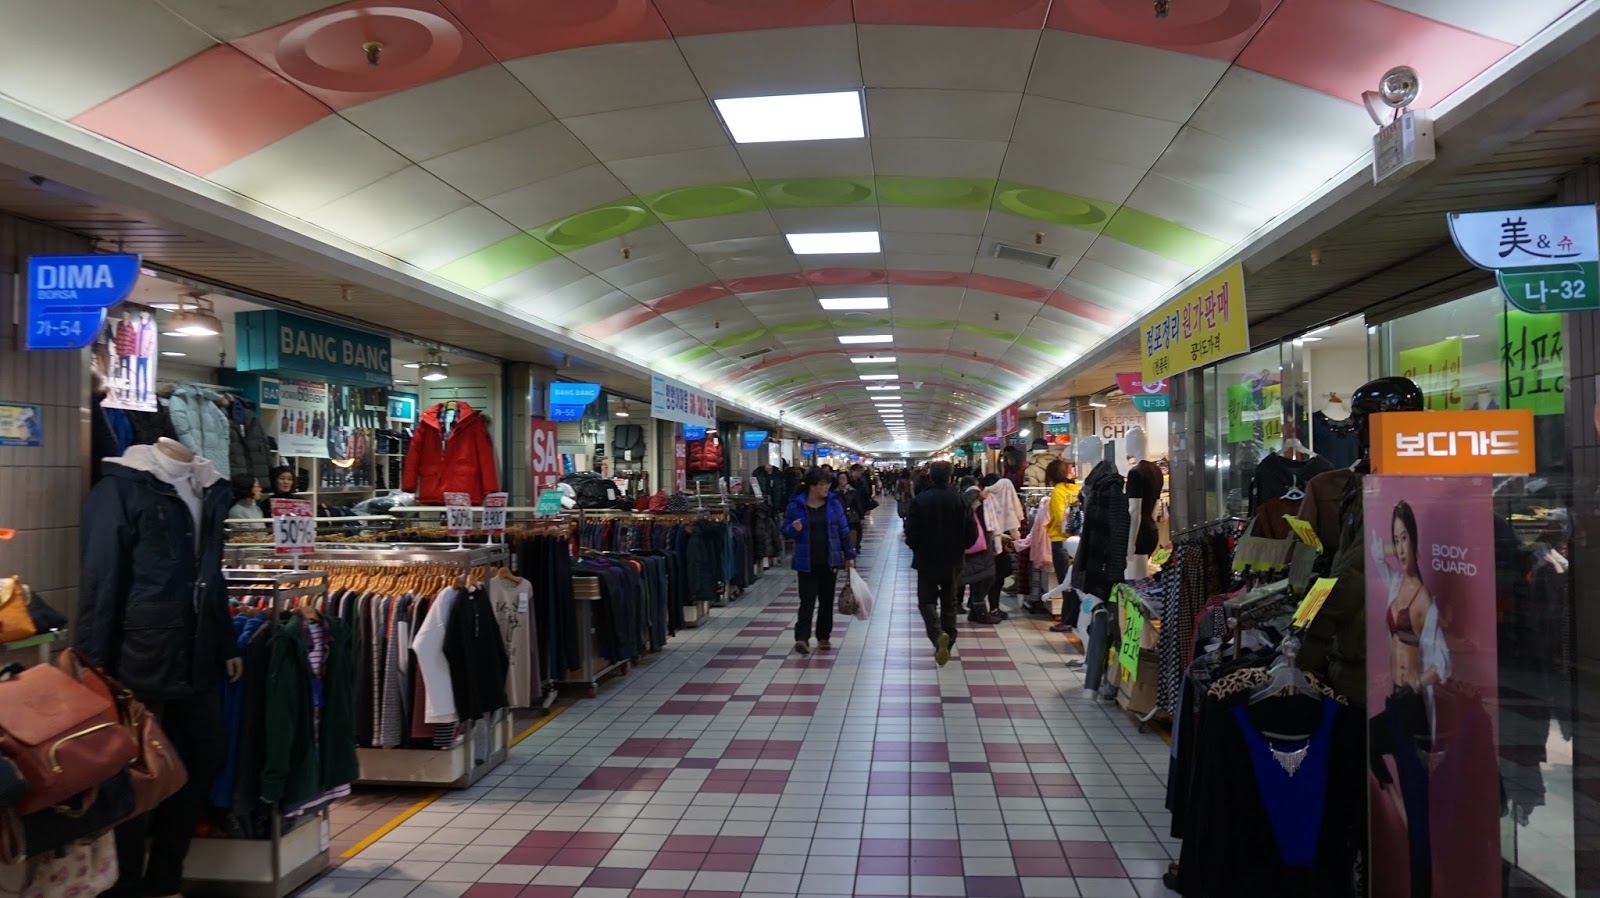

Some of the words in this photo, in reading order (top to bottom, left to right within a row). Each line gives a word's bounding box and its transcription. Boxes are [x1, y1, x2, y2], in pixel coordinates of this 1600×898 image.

[1537, 234, 1551, 249] &
[1557, 235, 1573, 252] 슈
[37, 265, 115, 290] DIMA
[37, 290, 78, 299] BORSA
[1525, 280, 1586, 303] 나-32
[36, 320, 82, 336] 가-54
[1146, 309, 1179, 358] 점포정리
[1182, 281, 1229, 340] 원가판매
[281, 325, 337, 363] BANG
[342, 339, 389, 373] BANG
[554, 408, 576, 416] 가-55
[1102, 416, 1142, 425] SECRET
[1102, 425, 1142, 439] CH
[533, 429, 557, 473] SA
[1396, 430, 1519, 457] 보디가드
[540, 502, 558, 511] 50%
[451, 508, 471, 527] 50%
[280, 519, 312, 544] 50%
[1432, 544, 1468, 560] BODY
[1432, 558, 1478, 576] GUARD
